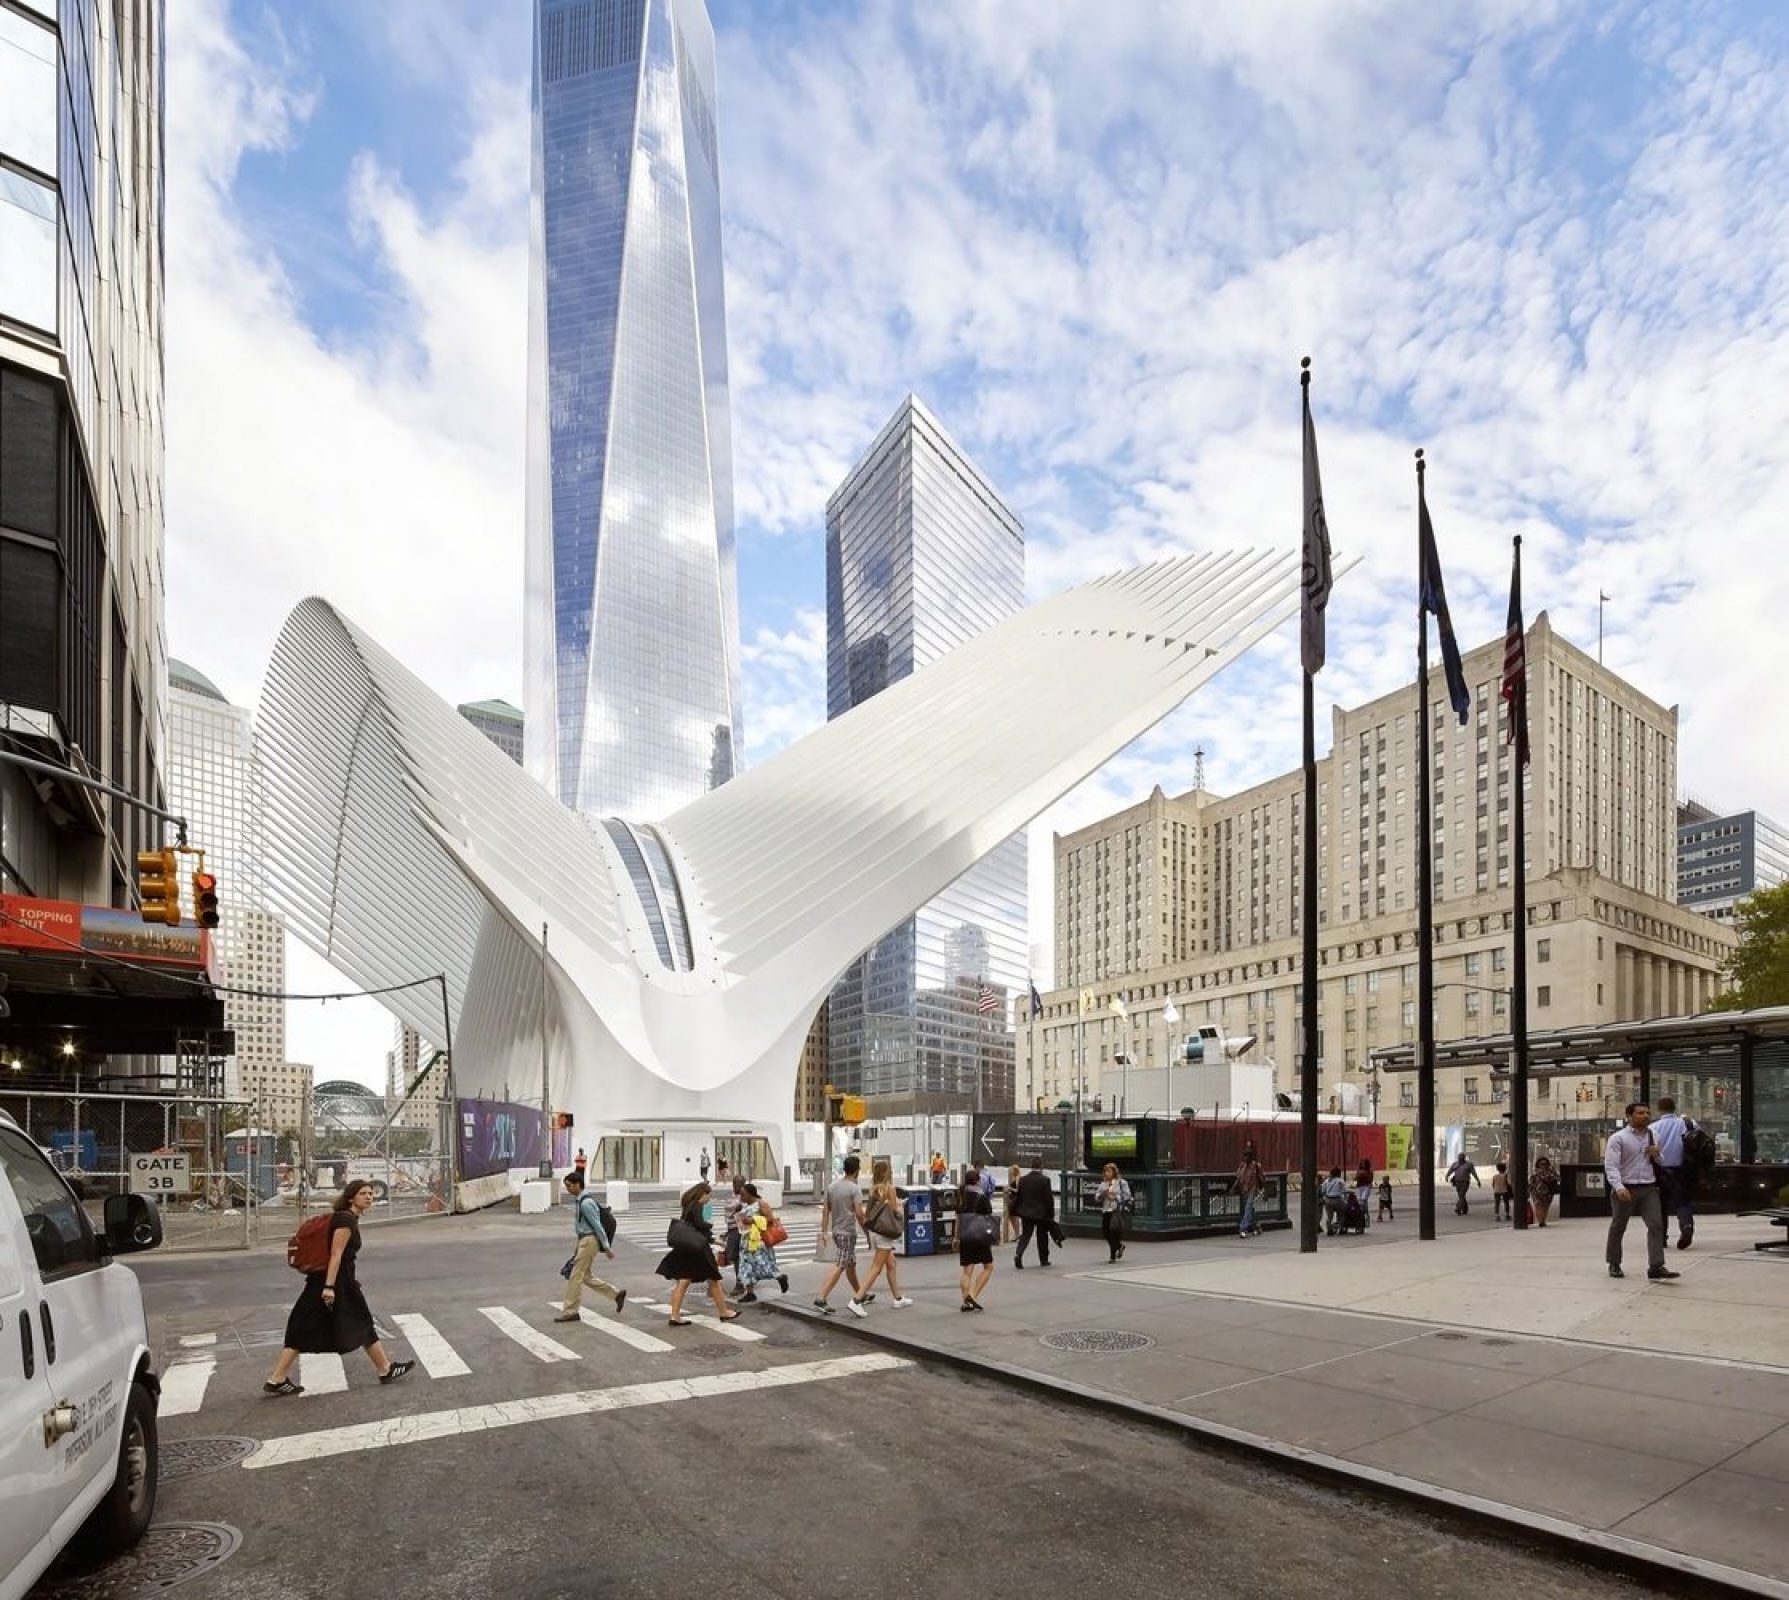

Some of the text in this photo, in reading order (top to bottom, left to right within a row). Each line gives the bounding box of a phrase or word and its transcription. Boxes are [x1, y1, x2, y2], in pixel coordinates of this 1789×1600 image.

[19, 908, 73, 924] TOPPING
[136, 1158, 184, 1170] GATE
[148, 1177, 174, 1189] 3B
